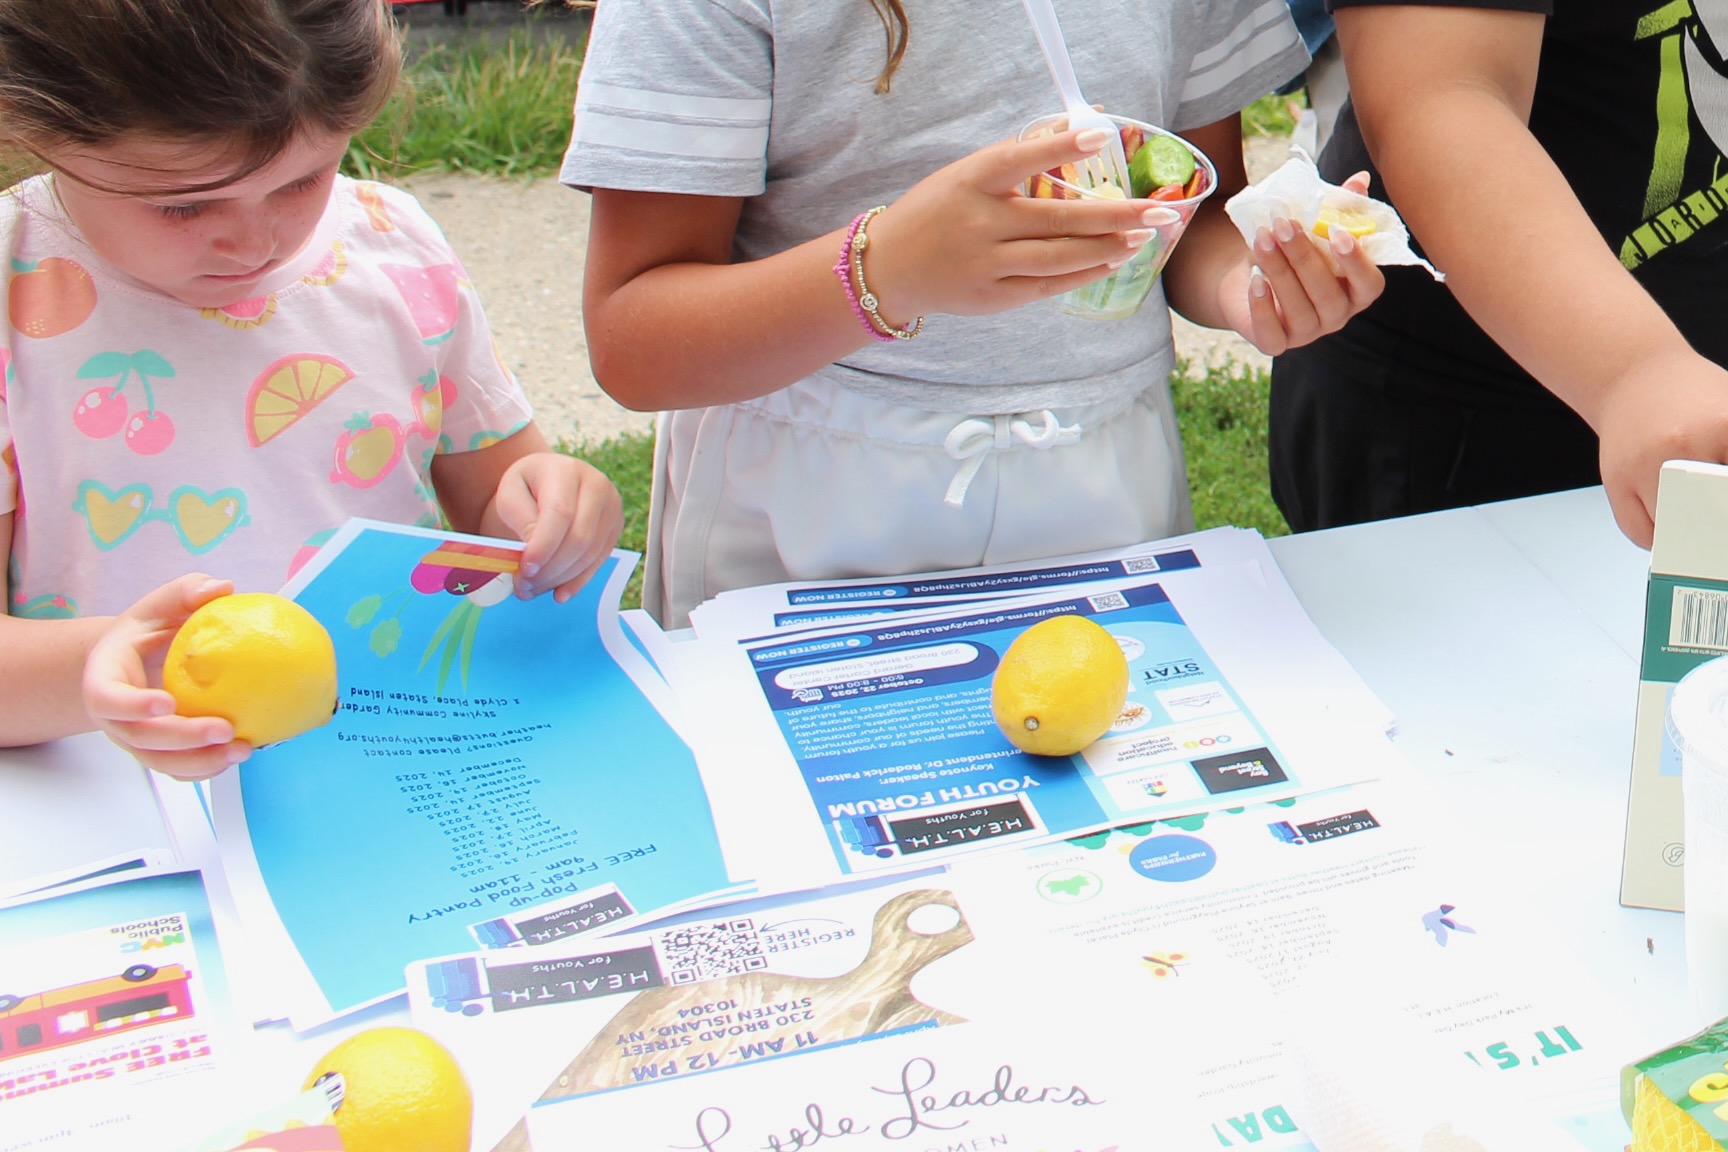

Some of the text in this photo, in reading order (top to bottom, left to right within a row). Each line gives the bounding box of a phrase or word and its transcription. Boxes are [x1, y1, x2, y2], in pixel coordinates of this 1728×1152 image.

[793, 590, 881, 603] REGISTER NOW
[755, 641, 844, 661] REGISTER NOW
[1143, 662, 1200, 680] STAT
[827, 683, 844, 692] PM
[879, 678, 924, 691] October
[350, 687, 508, 707] Clyde Place, Staten Island
[801, 696, 934, 721] contribute future
[387, 706, 496, 719] Skyline Community
[784, 706, 820, 716] youth.
[820, 717, 853, 727] share
[790, 721, 818, 731] your
[794, 712, 939, 738] local community
[813, 714, 969, 742] youth forum chance
[363, 749, 412, 758] contact
[418, 748, 461, 756] Please
[804, 729, 985, 758] Please for youth forum
[1117, 746, 1177, 762] healthcare
[1118, 742, 1173, 756] education
[1131, 736, 1170, 749] project
[395, 758, 522, 783] December 2025
[399, 765, 526, 794] November 2025
[862, 760, 943, 777] Dr. Roderick
[879, 763, 994, 786] Keynote Speaker:
[407, 779, 541, 814] September 2025
[411, 774, 526, 803] October 2025
[828, 775, 1040, 818] YOUTH FORUM
[427, 790, 530, 820] August 2025
[439, 799, 531, 827] July 2025
[443, 806, 537, 835] June 2025
[452, 813, 542, 843] May 2025
[925, 808, 988, 826] for Youths
[452, 819, 551, 852] April 2025
[456, 825, 560, 860] March 2025
[449, 830, 578, 872] February 2025
[460, 839, 578, 878] January 2025
[1140, 854, 1168, 865] PARKS
[1143, 850, 1207, 870] PARTNERSHIPS
[408, 844, 658, 924] FREE Fresh Food Pantry
[469, 856, 584, 894] 9am 11am
[509, 882, 578, 907] Pop-up
[110, 916, 181, 935] Schools
[543, 909, 578, 922] Youths
[127, 923, 184, 940] Public
[761, 928, 810, 944] HERE
[768, 928, 855, 953] REGISTER
[119, 933, 185, 954] NYC
[531, 954, 613, 974] for Youths
[677, 999, 738, 1019] 10304
[615, 997, 813, 1046] STATEN ISLAND, NY
[172, 1034, 208, 1048] at
[620, 1009, 814, 1058] 230 BROAD STREET
[68, 1045, 162, 1072] Clove
[127, 1046, 211, 1072] FREE
[631, 1031, 819, 1082] 11 12 PM
[870, 1057, 1106, 1140] Leaders
